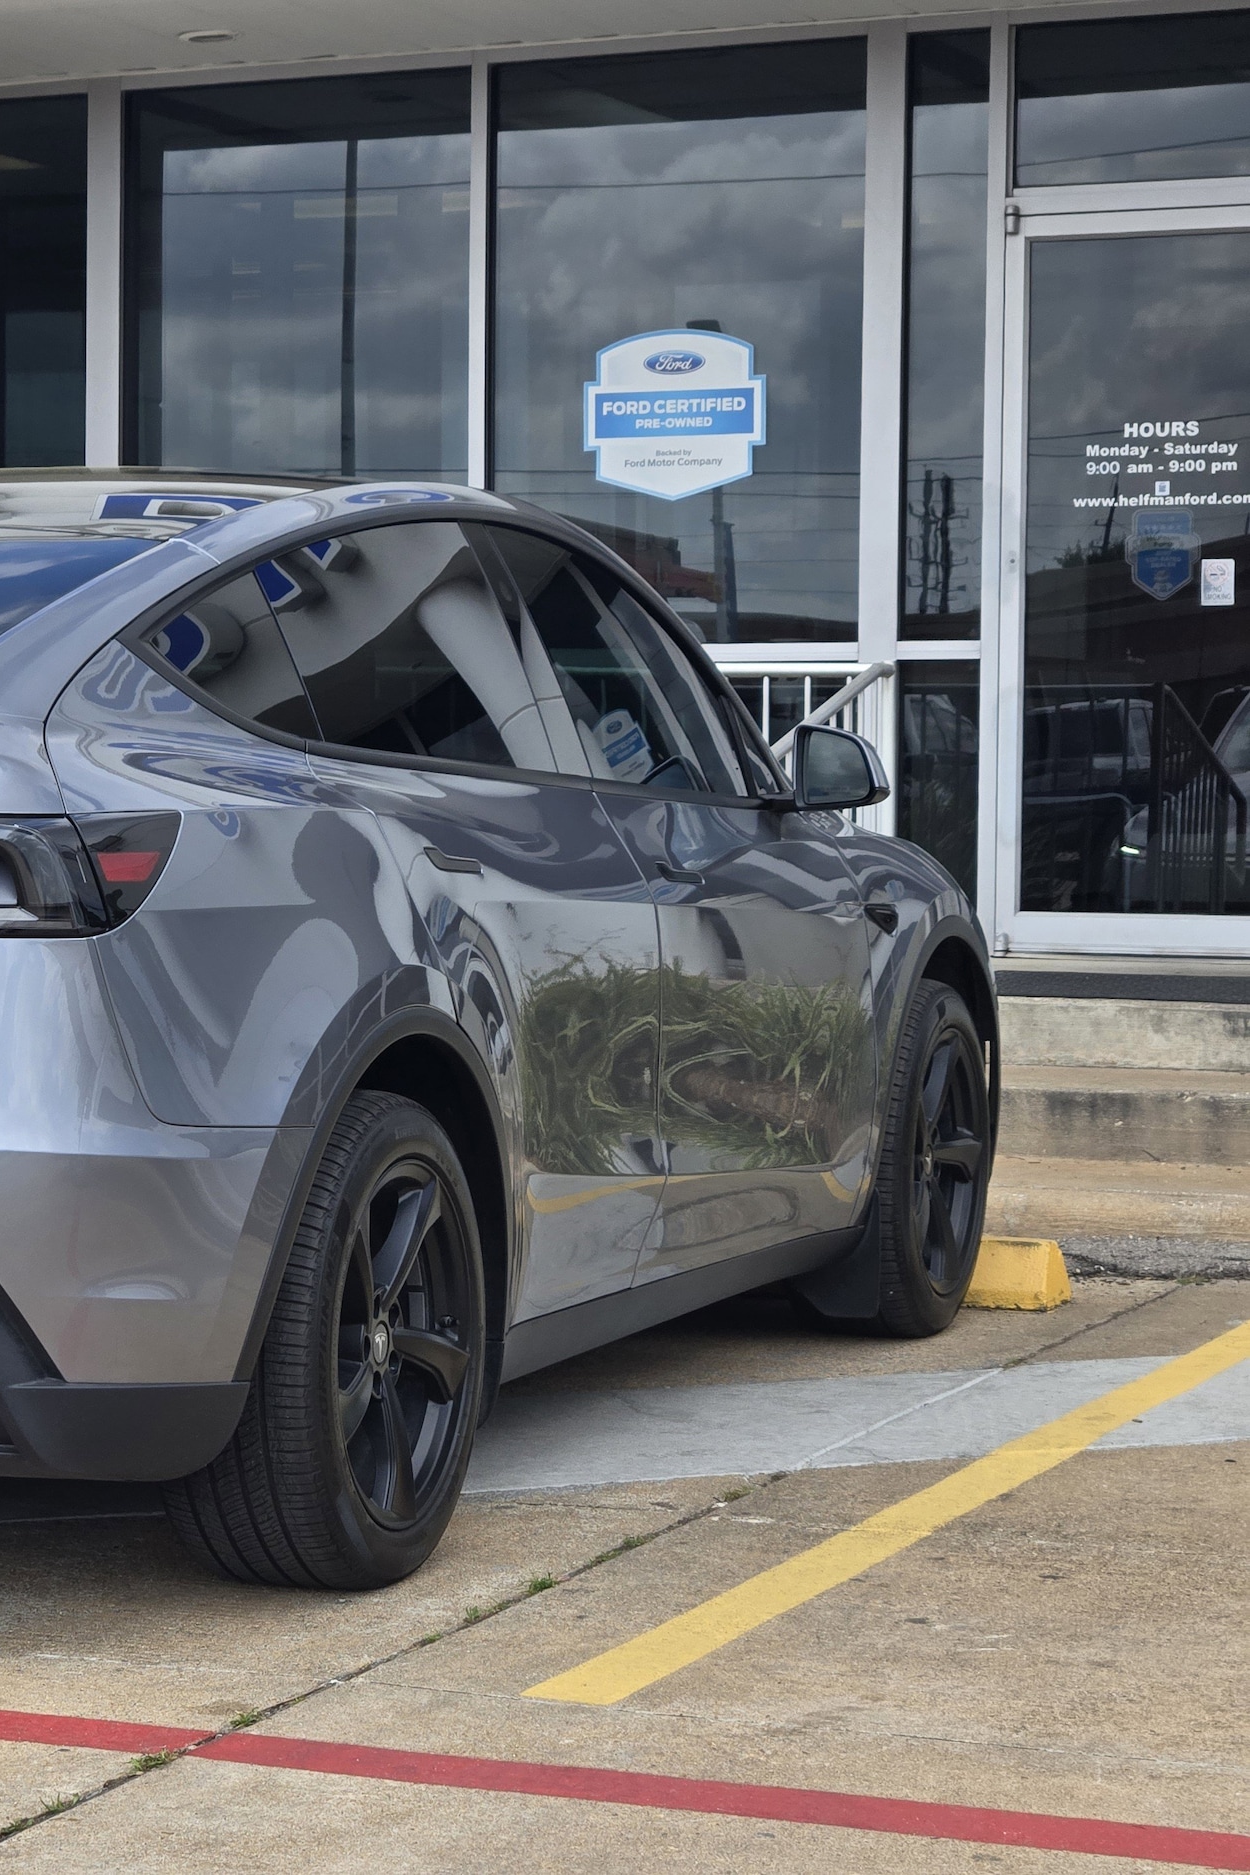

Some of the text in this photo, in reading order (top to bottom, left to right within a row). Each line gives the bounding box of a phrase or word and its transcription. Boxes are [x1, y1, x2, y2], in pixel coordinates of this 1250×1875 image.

[602, 397, 746, 416] FORD CERTIFIED
[635, 416, 713, 429] PRE-OWNED
[1123, 421, 1200, 438] HOURS
[655, 449, 692, 458] Backed by
[1086, 444, 1149, 459] Monday
[1164, 441, 1239, 457] Saturday
[624, 457, 723, 468] Ford Motor Company
[1086, 461, 1120, 475] 9:00
[1127, 463, 1153, 474] am
[1169, 460, 1206, 473] 9:00
[1211, 460, 1238, 474] pm
